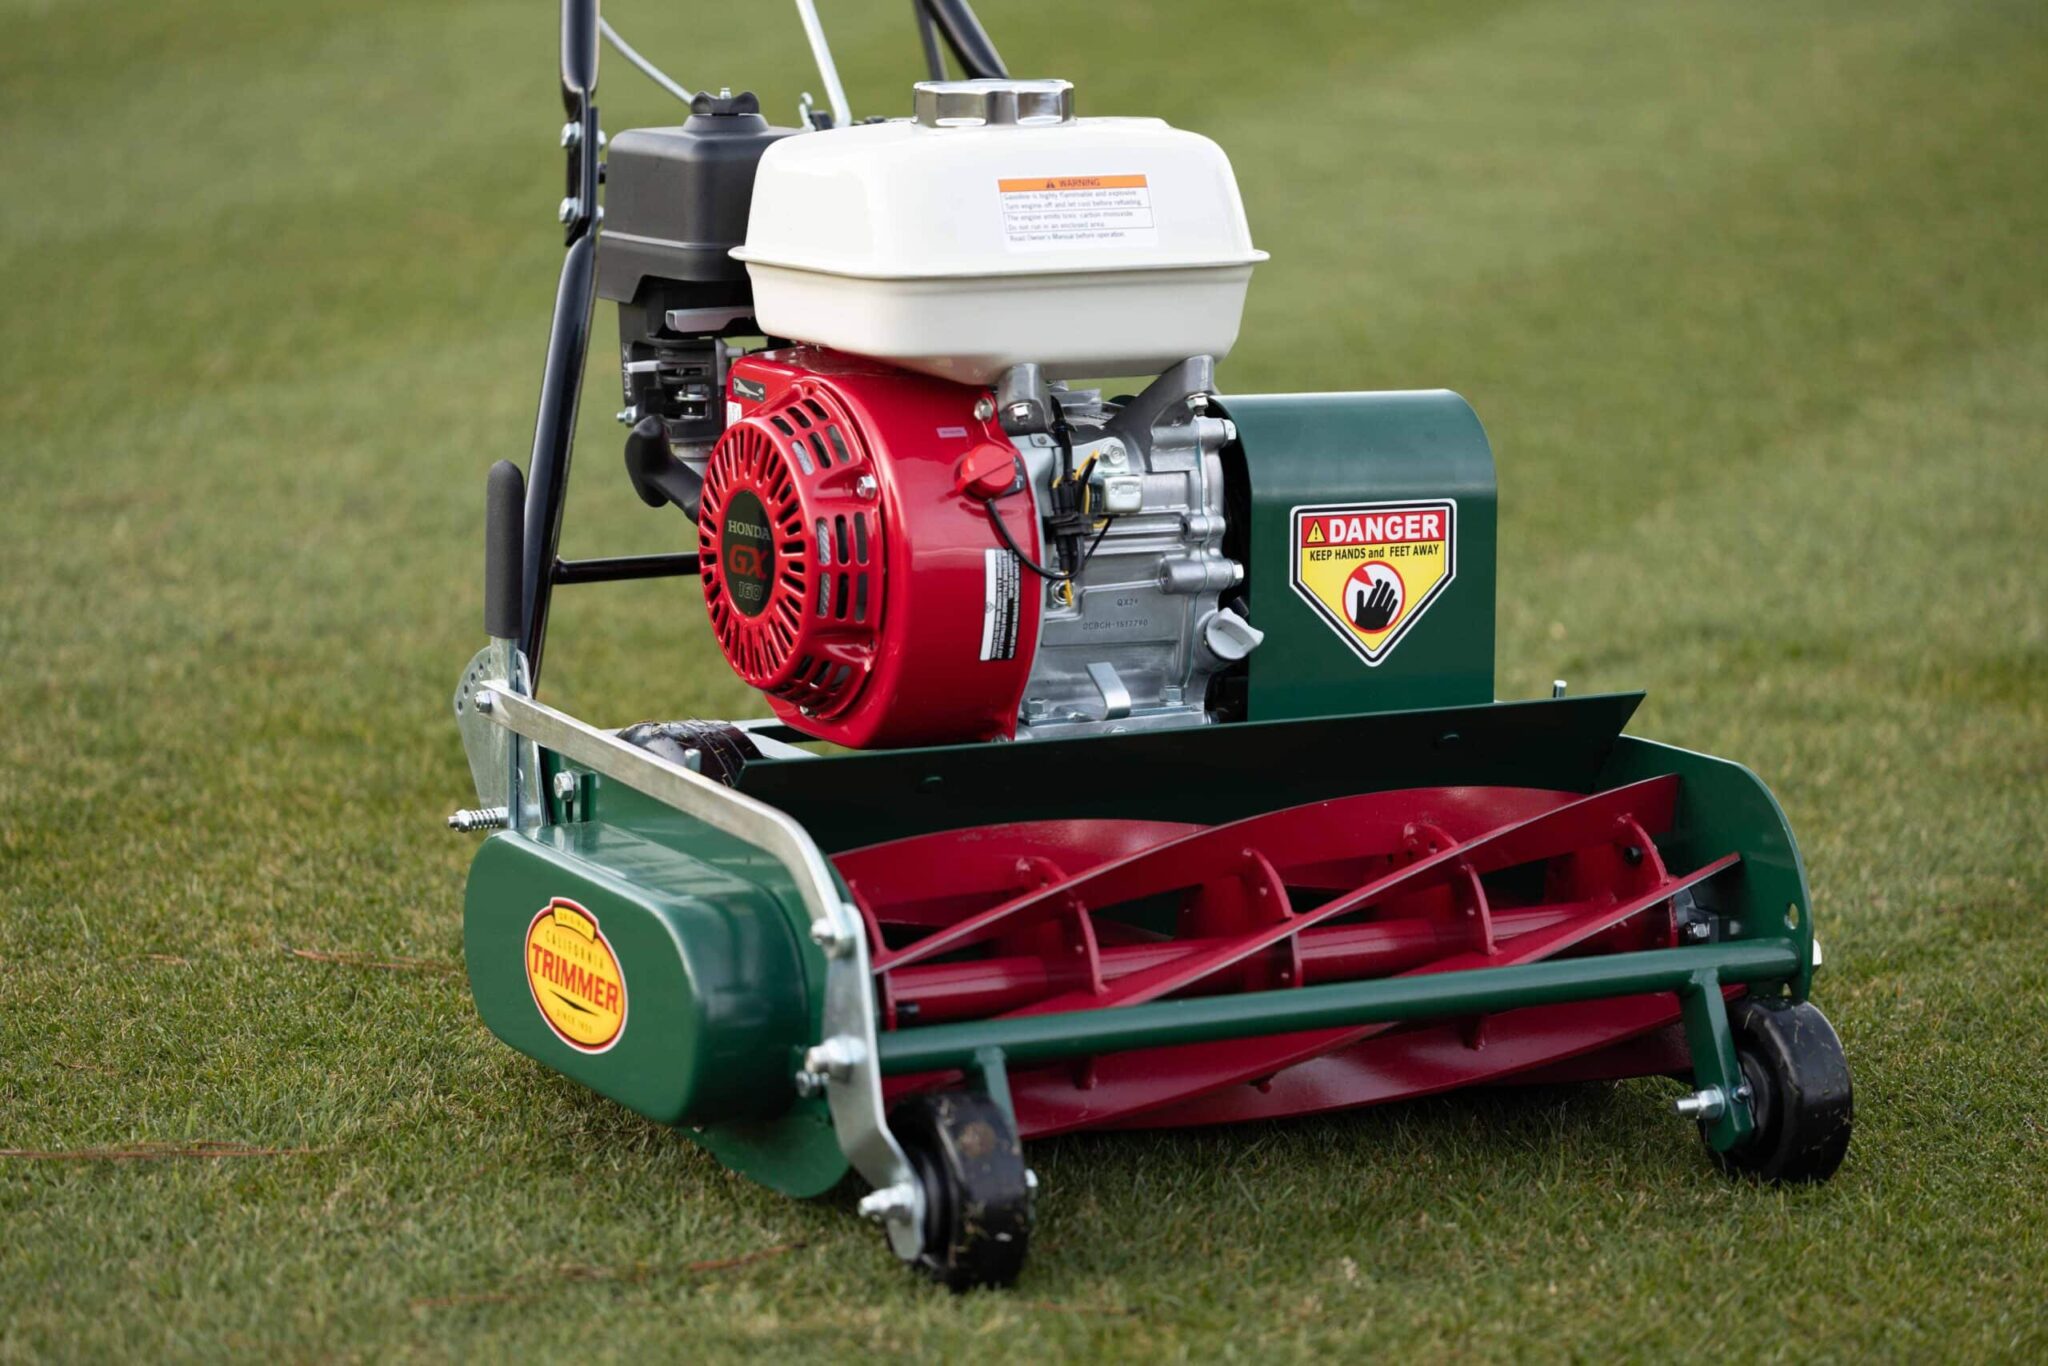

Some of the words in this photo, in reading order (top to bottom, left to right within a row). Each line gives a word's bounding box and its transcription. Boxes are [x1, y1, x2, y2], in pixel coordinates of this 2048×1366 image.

[1060, 178, 1100, 187] WARNING
[728, 520, 771, 540] HONDA
[1329, 514, 1440, 543] DANGER
[729, 544, 768, 580] GX
[1310, 551, 1332, 561] KEEP
[1335, 548, 1366, 560] HANDS
[1368, 547, 1384, 558] and
[1390, 546, 1410, 557] FEET
[1413, 544, 1439, 556] AWAY
[738, 581, 762, 600] 160
[545, 929, 603, 970] CALIFORNIA
[532, 943, 618, 1014] TRIMMER
